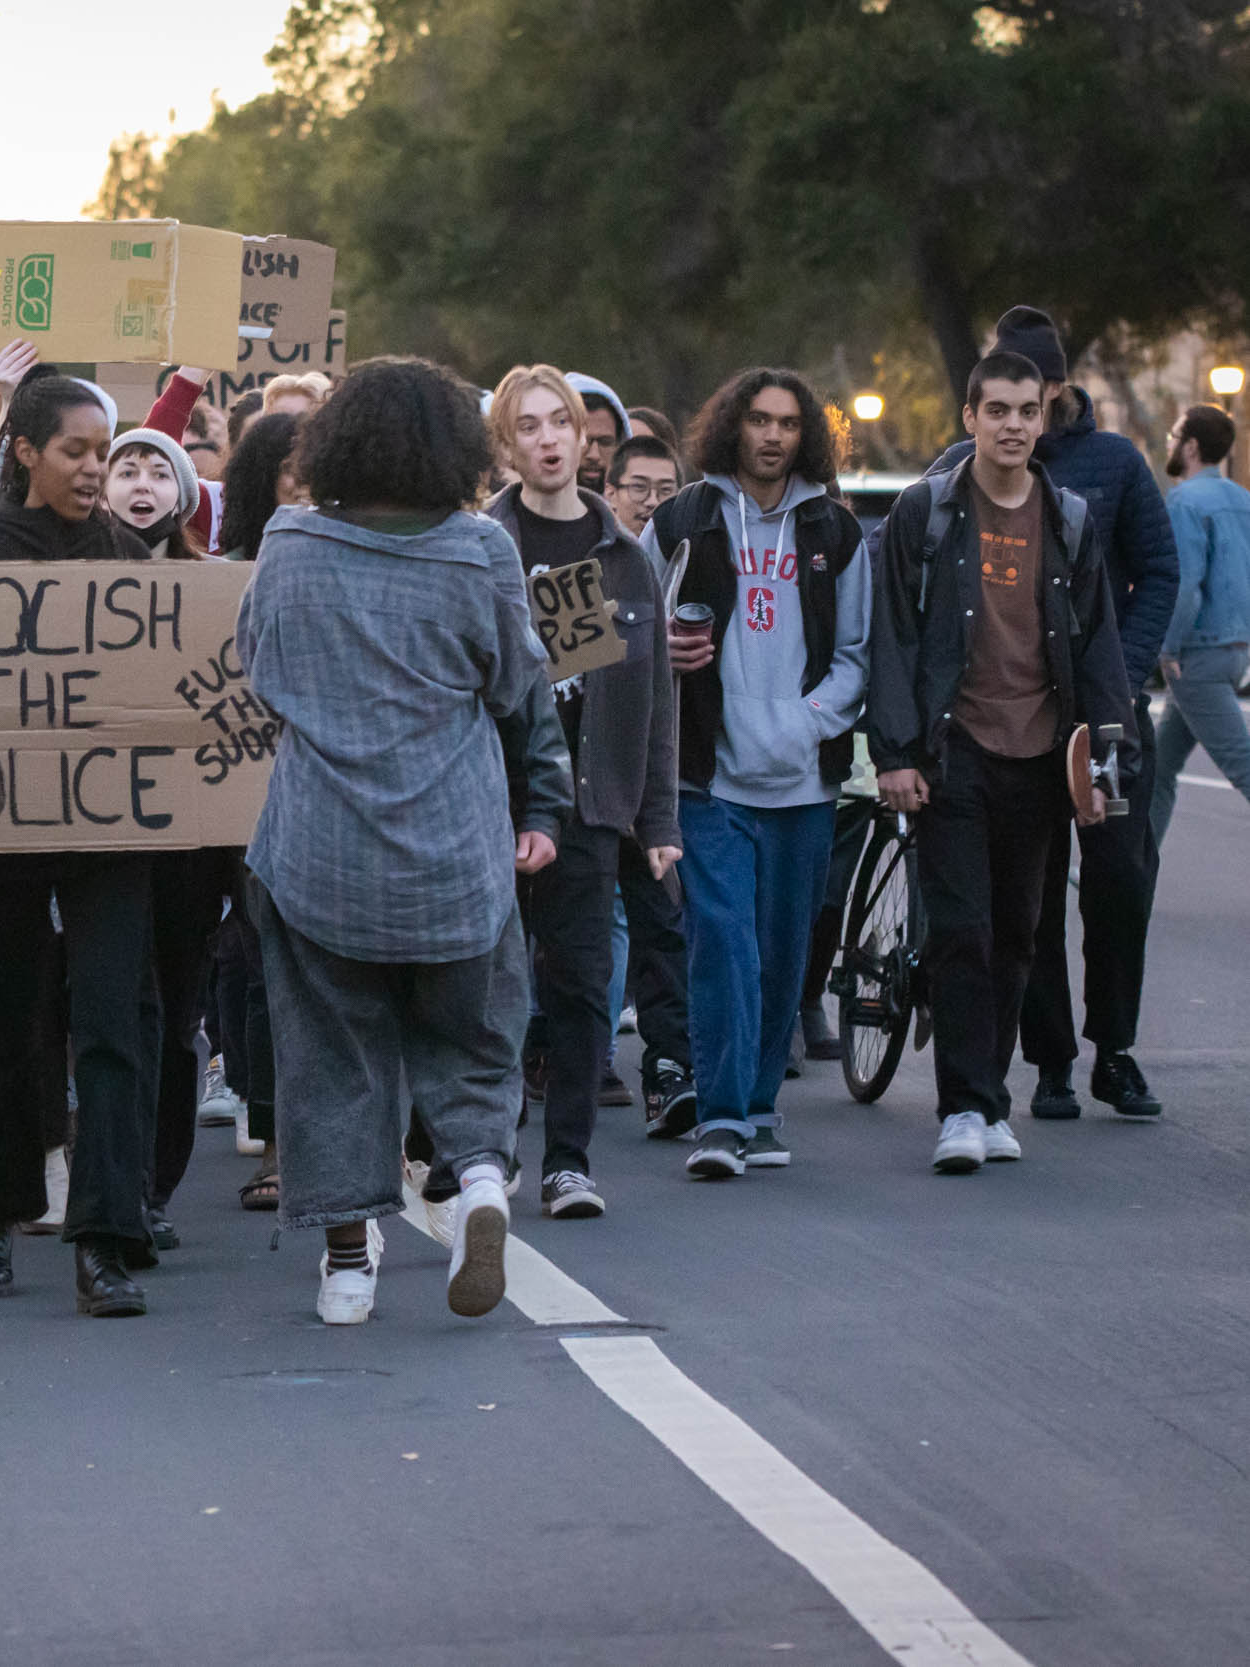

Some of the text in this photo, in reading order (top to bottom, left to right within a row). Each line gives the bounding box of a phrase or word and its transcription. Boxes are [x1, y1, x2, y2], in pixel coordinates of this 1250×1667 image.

[242, 250, 299, 279] LISH
[2, 258, 15, 328] PRODUCTS
[240, 303, 278, 326] ICE
[533, 563, 594, 616] OFF
[538, 611, 604, 665] PUS
[174, 637, 245, 710] FUC
